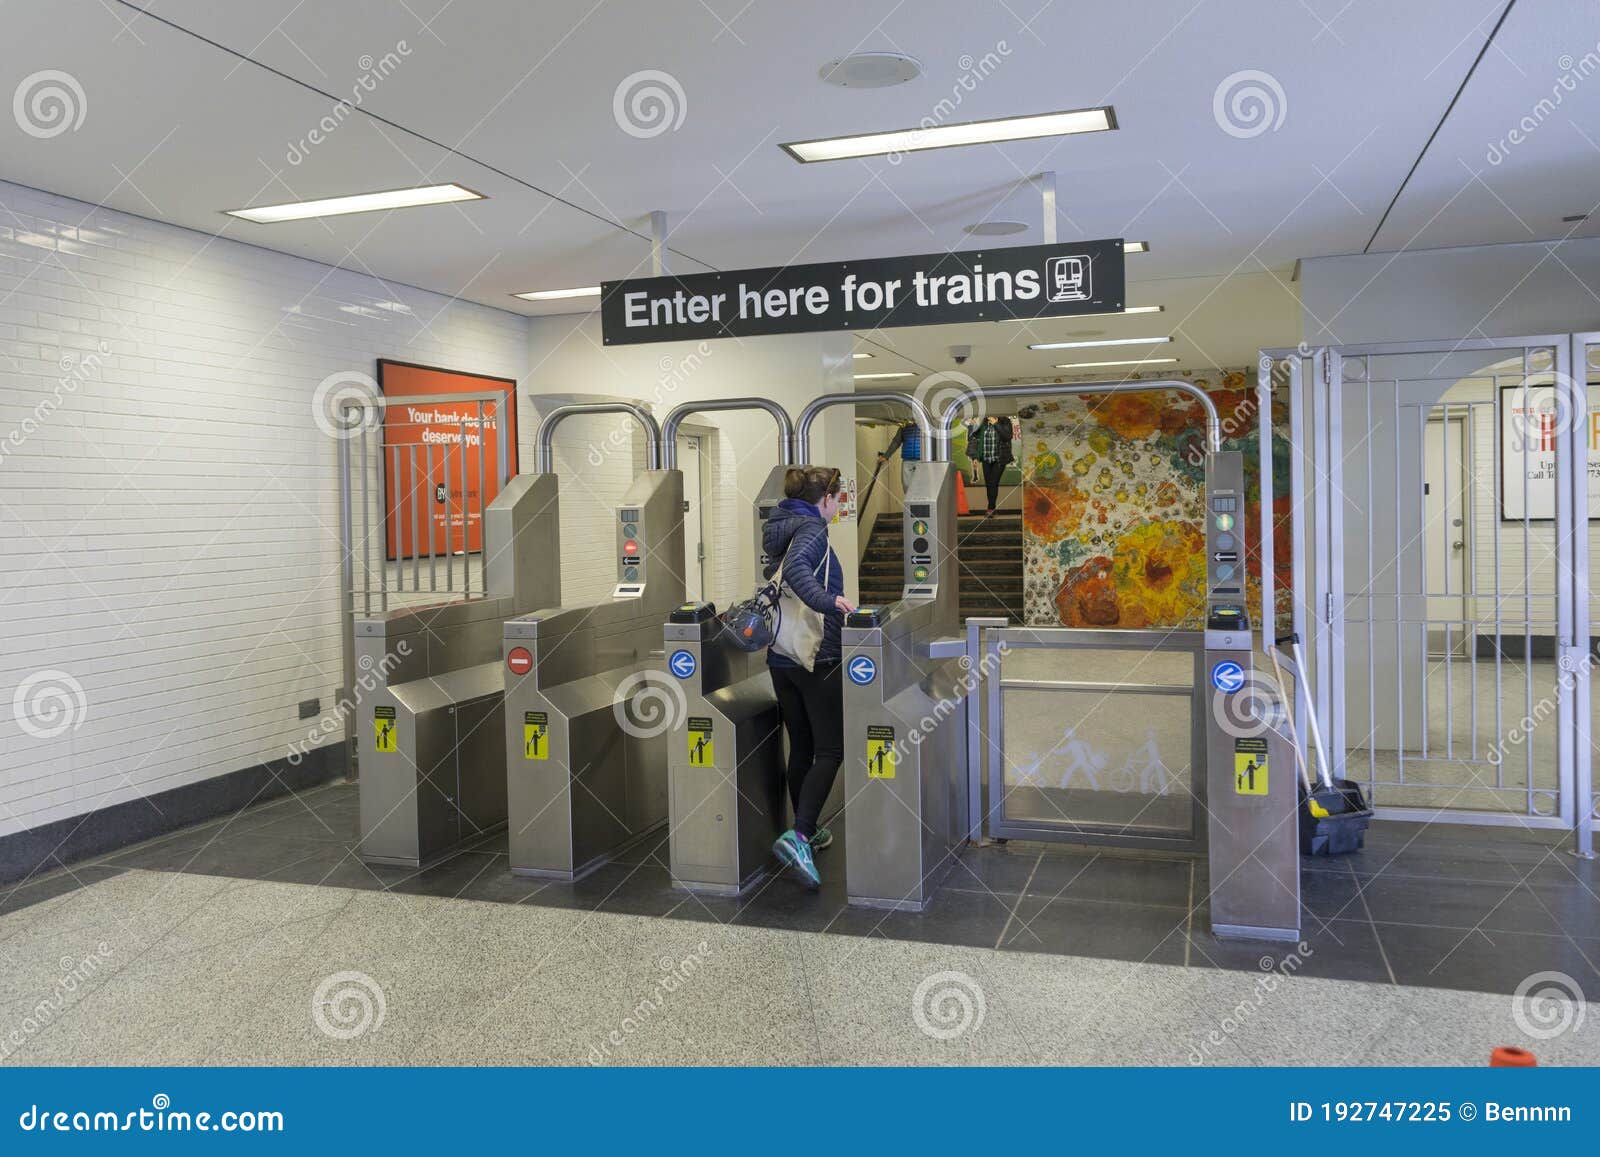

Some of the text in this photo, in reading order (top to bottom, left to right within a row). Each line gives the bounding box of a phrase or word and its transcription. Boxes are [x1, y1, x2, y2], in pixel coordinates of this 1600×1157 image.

[624, 264, 1041, 328] Enter here for trains
[407, 407, 433, 425] Your
[434, 409, 461, 427] bank
